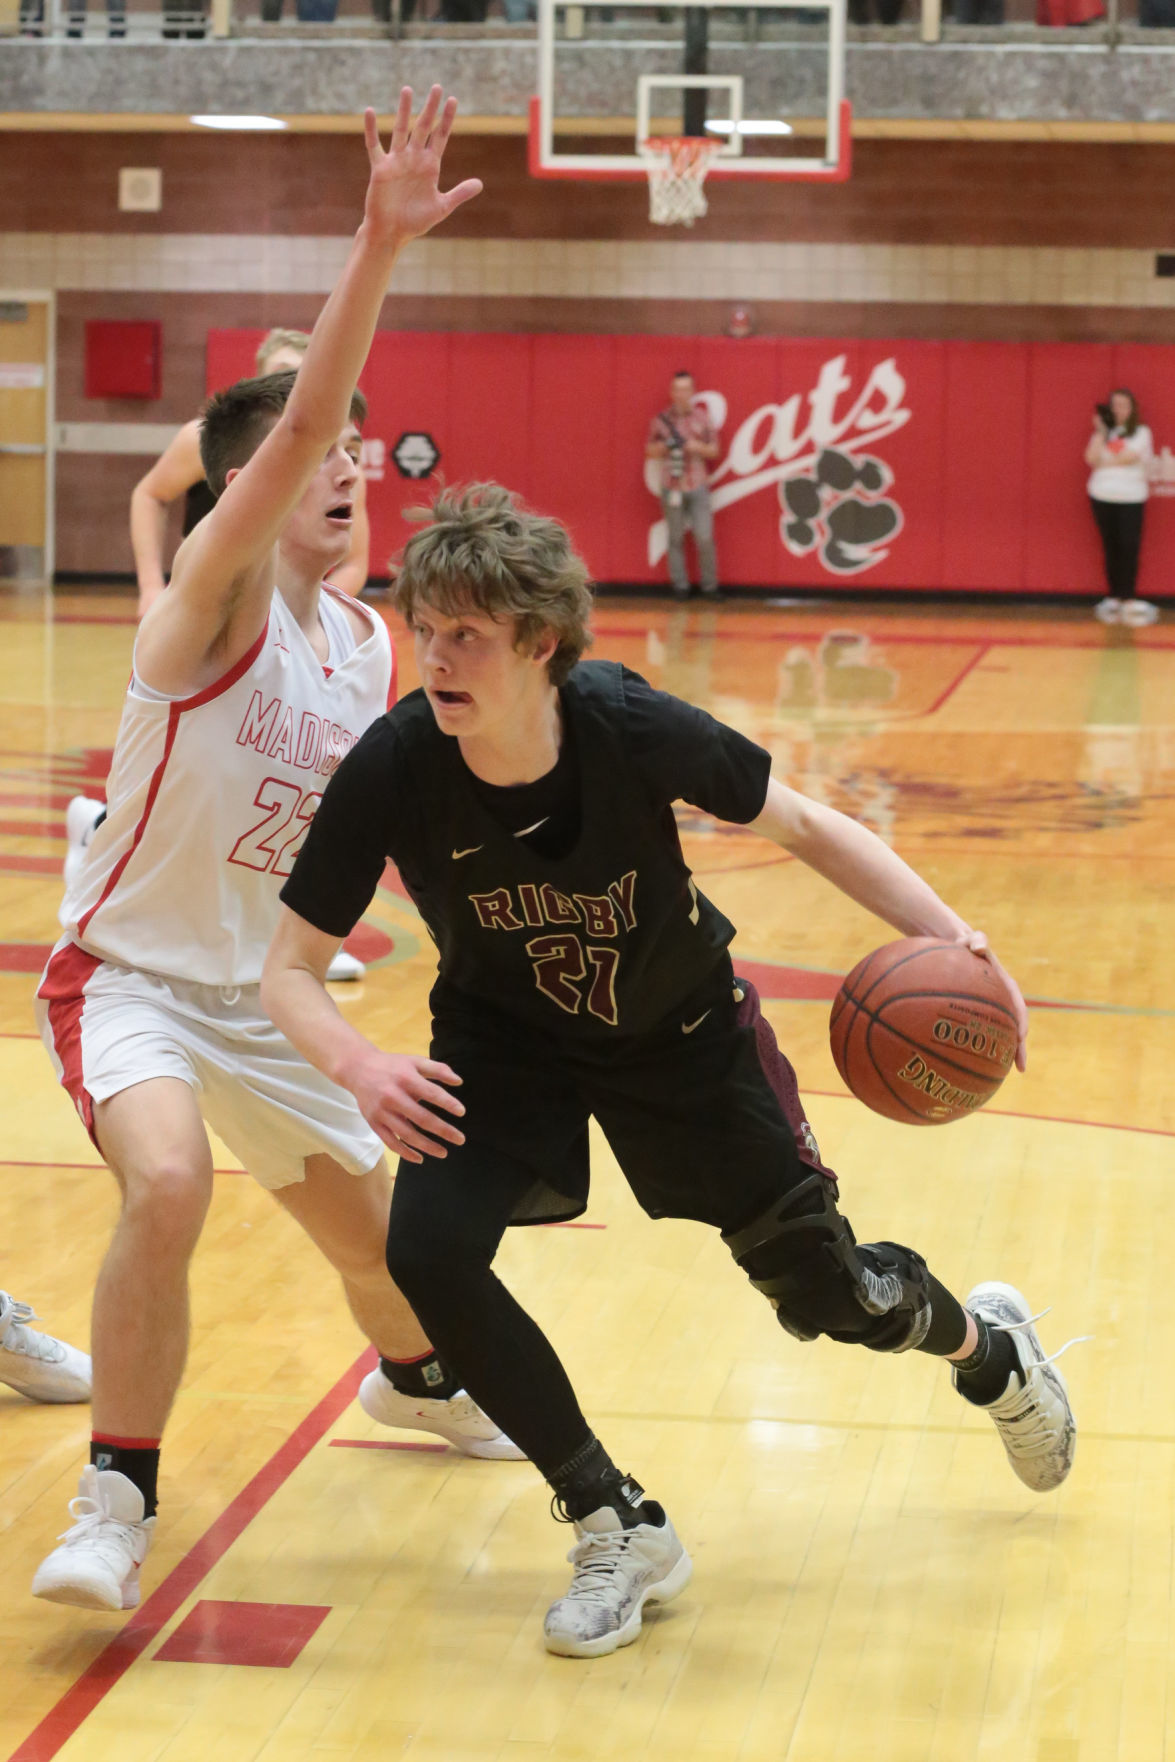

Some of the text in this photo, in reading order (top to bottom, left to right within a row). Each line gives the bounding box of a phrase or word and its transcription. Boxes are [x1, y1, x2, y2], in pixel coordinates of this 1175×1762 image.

[235, 688, 360, 778] MADISO
[468, 869, 638, 938] RIGBY
[525, 933, 620, 1026] 21
